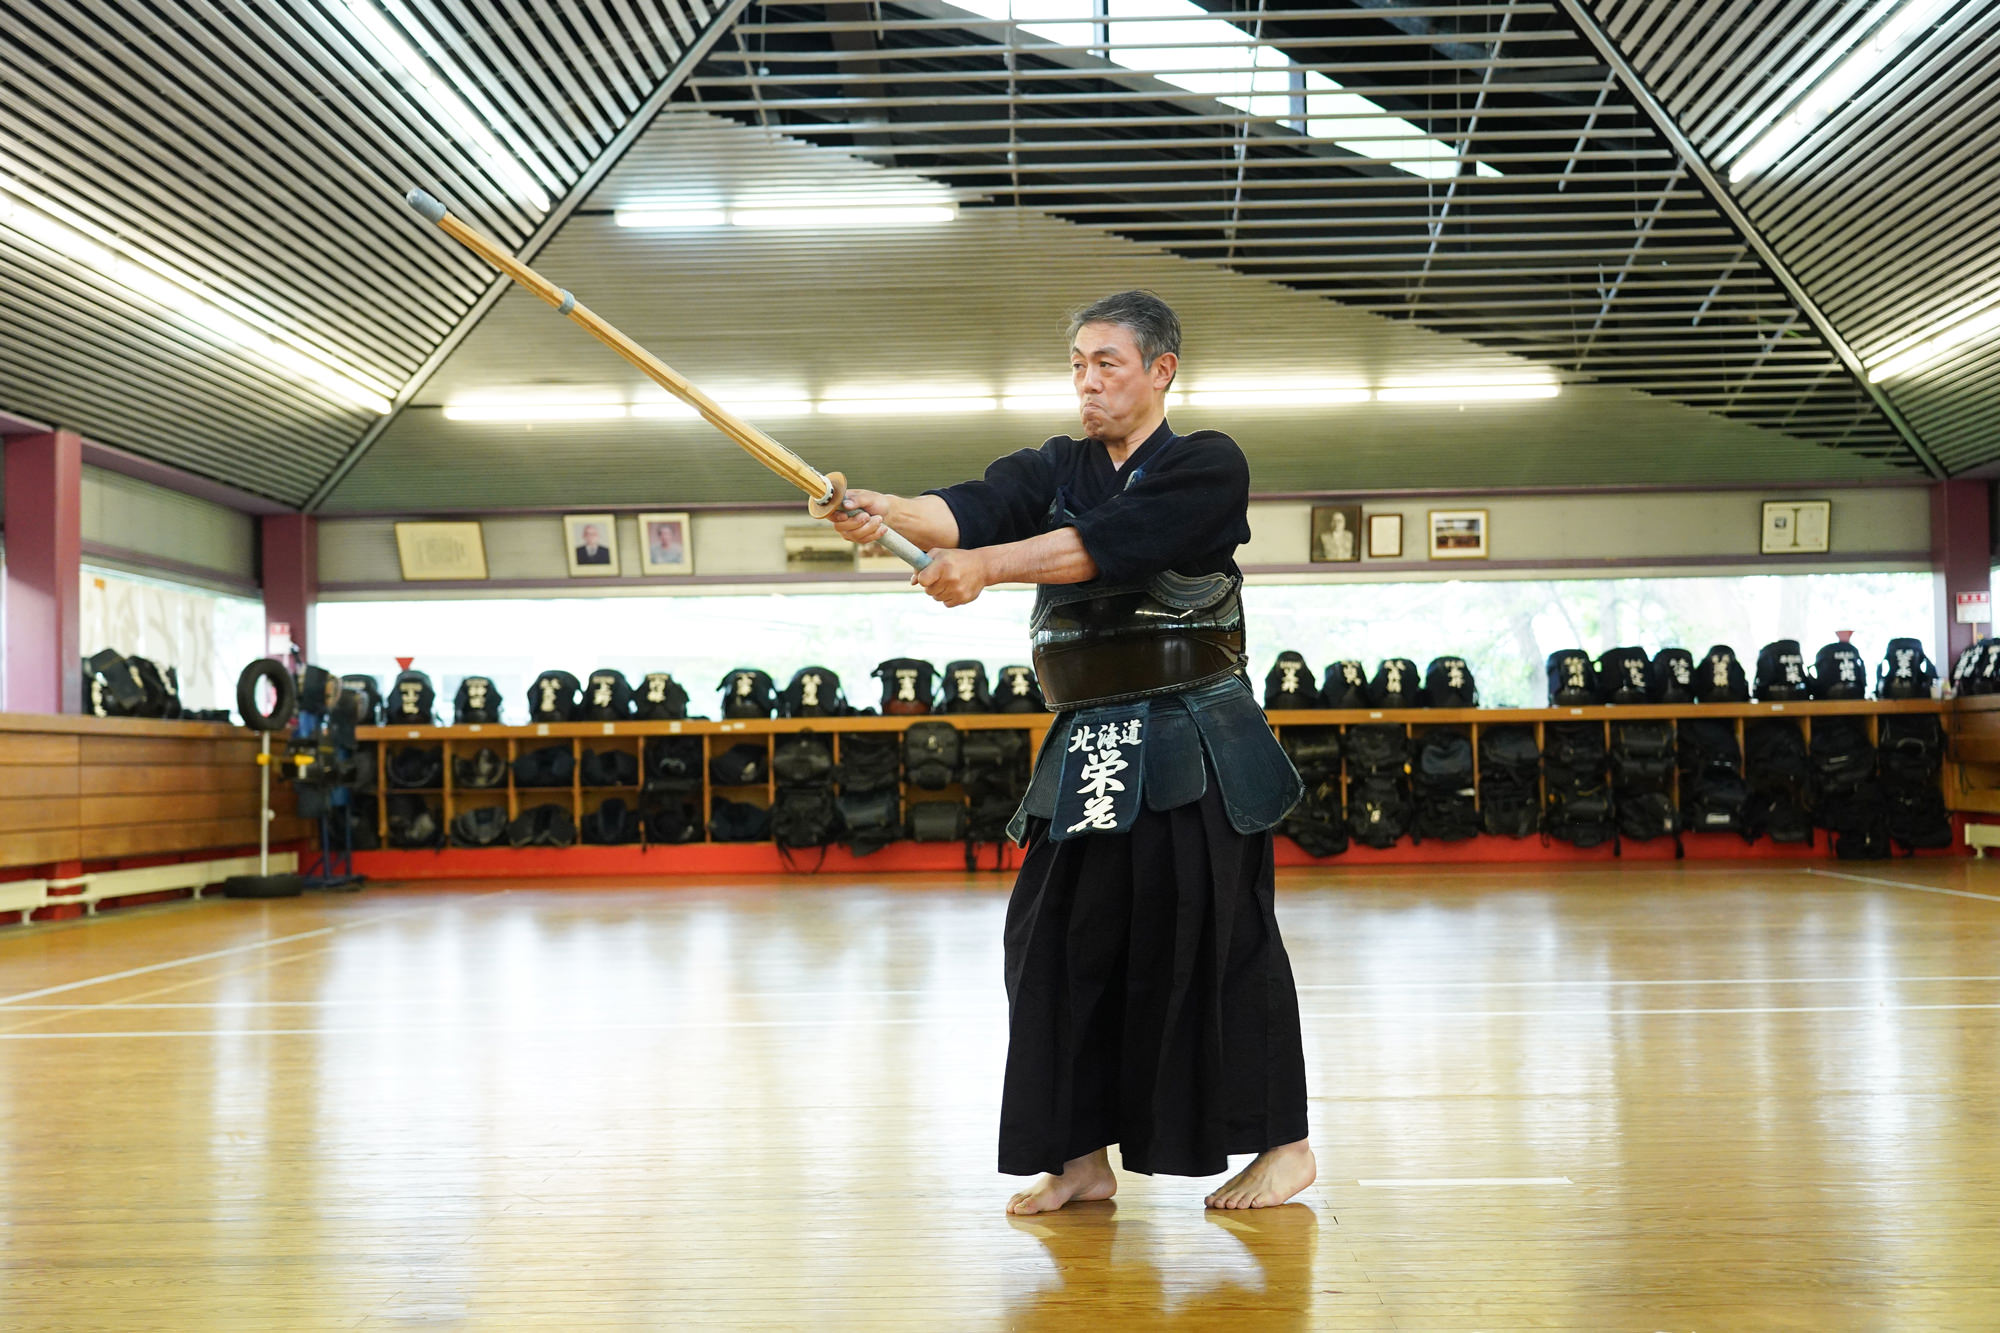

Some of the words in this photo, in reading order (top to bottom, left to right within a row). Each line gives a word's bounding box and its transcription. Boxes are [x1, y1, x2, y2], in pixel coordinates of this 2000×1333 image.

[1068, 719, 1142, 753] 北海道
[1067, 749, 1128, 833] 栄花
